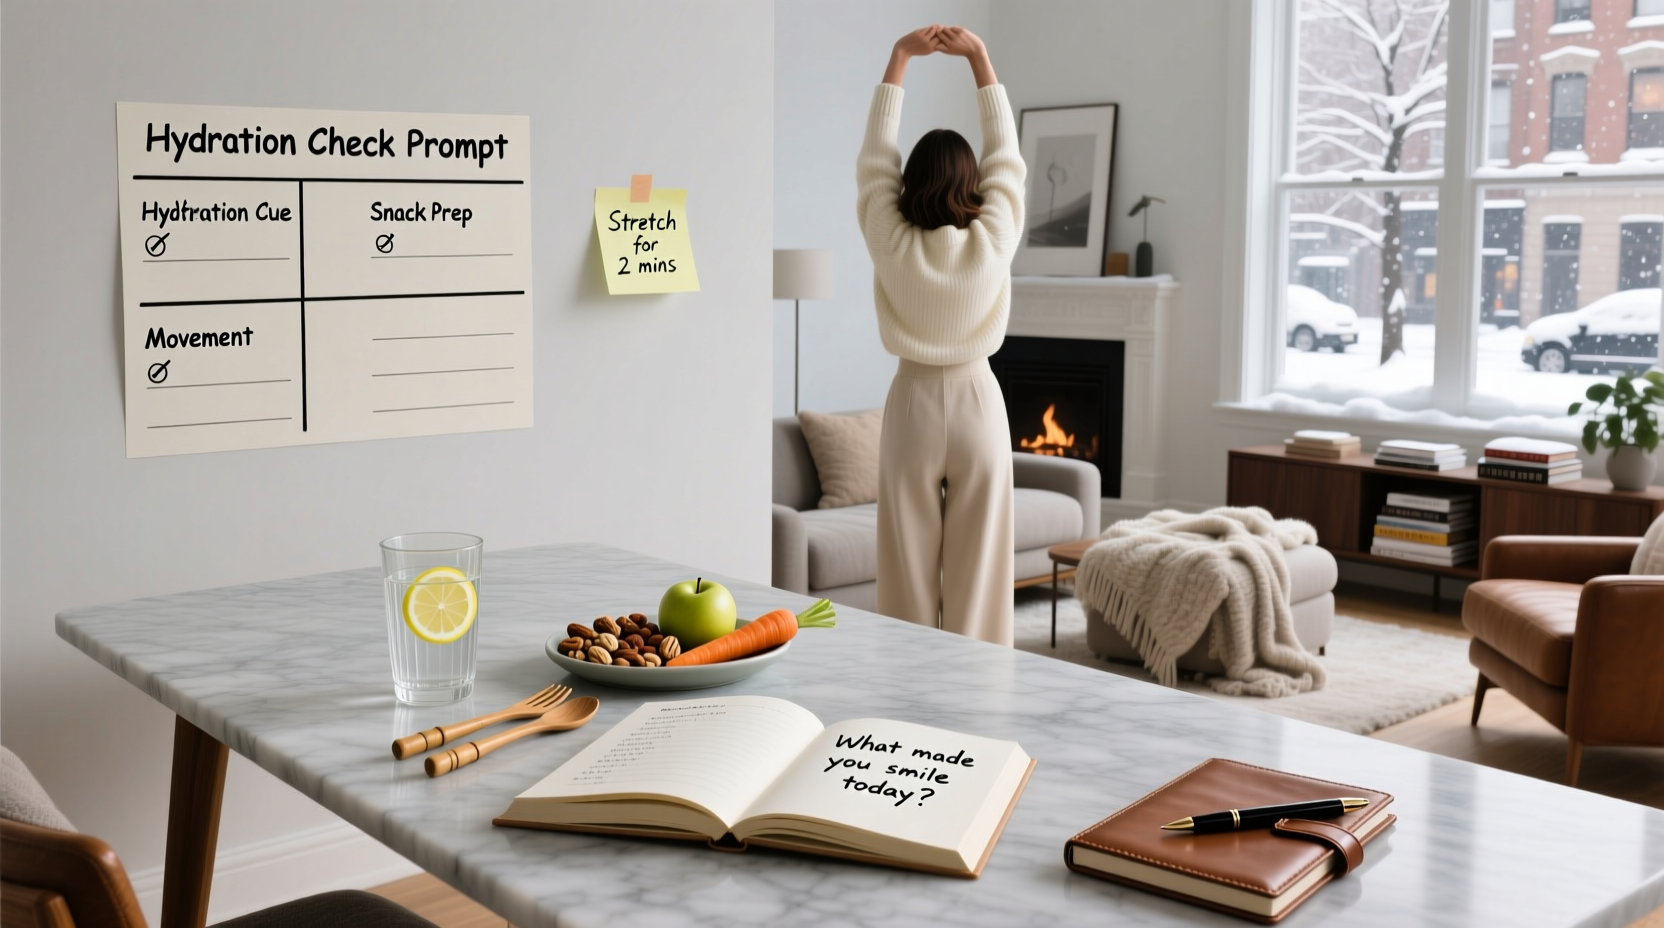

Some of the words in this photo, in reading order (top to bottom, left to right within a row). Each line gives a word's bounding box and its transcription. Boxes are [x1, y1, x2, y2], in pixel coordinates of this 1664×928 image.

[146, 122, 297, 164] Hydration
[307, 125, 396, 158] Check
[407, 128, 509, 169] Prompt
[255, 201, 292, 222] Cue
[370, 201, 427, 222] Snack
[431, 201, 473, 229] Prep
[608, 209, 676, 232] Stretch
[632, 234, 659, 255] for
[617, 256, 631, 276] 2
[638, 257, 677, 273] mins
[144, 326, 254, 350] Movement
[835, 734, 902, 754] What
[911, 749, 975, 767] made
[823, 757, 871, 773] you
[885, 764, 950, 785] smile
